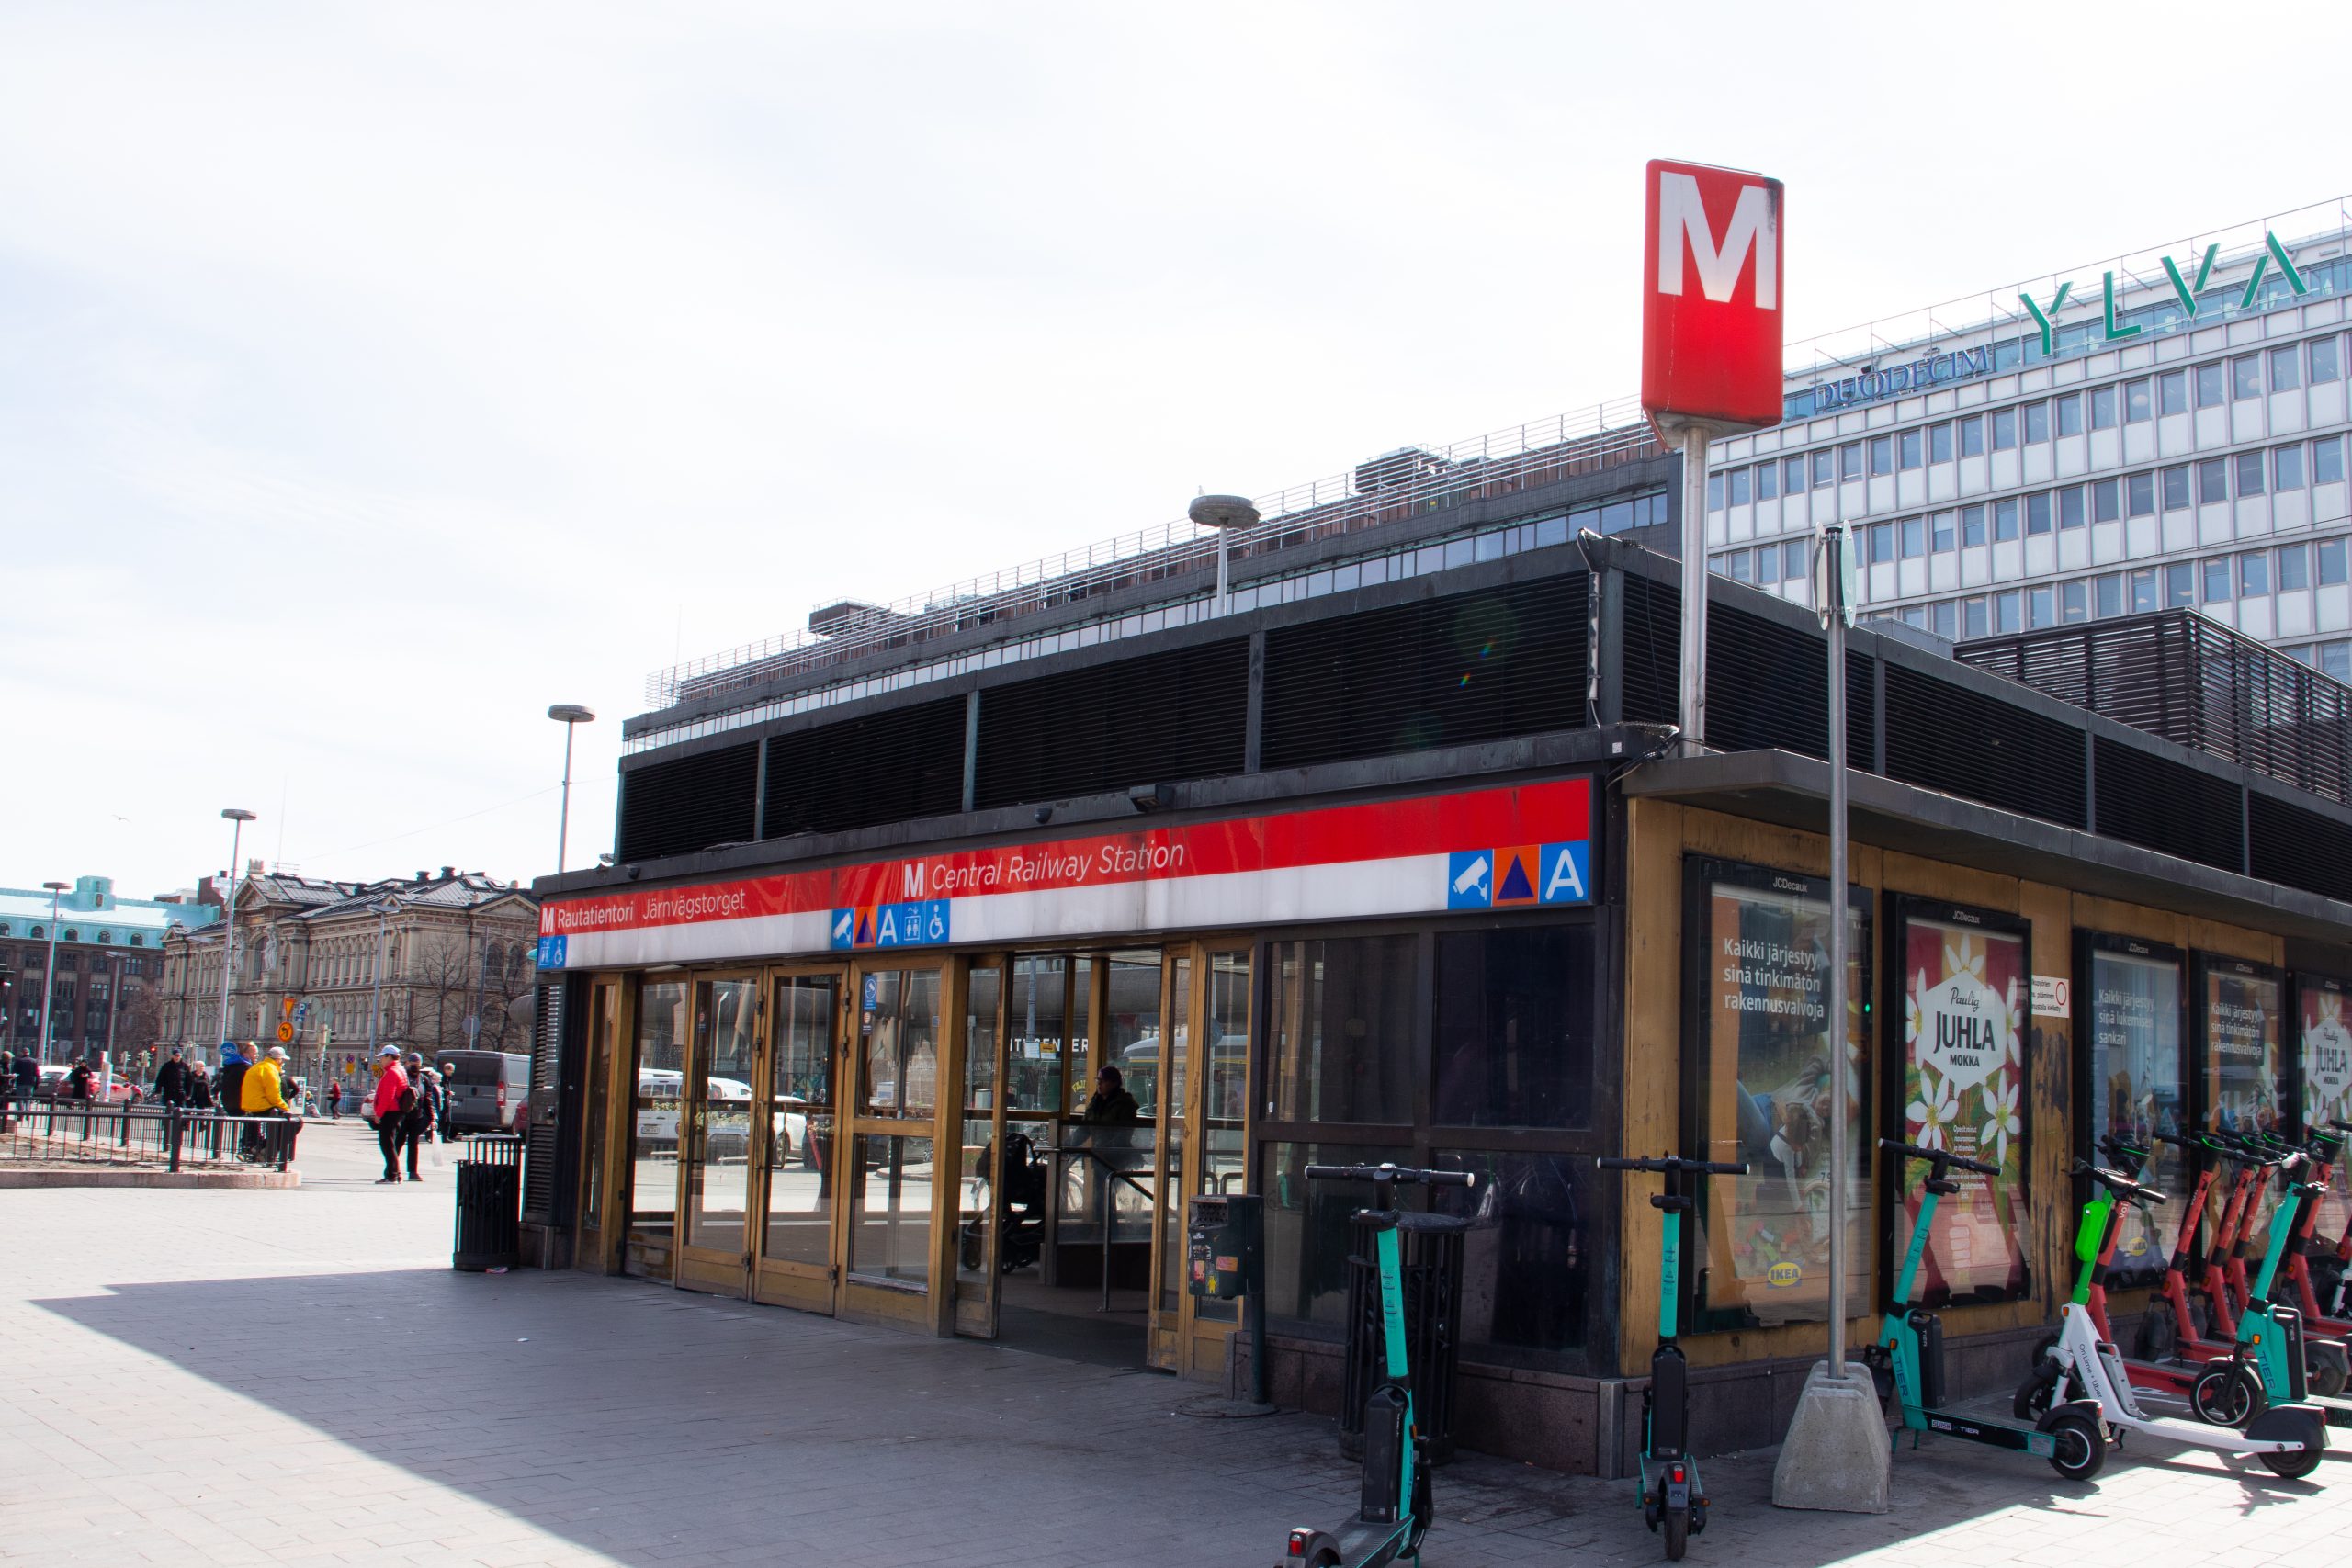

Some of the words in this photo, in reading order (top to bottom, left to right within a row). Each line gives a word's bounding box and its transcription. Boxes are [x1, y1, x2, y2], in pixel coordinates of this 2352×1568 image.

[1657, 170, 1777, 310] M
[2018, 230, 2310, 357] YLVA
[1813, 344, 1991, 412] DUODECIM
[903, 862, 925, 898] M
[932, 861, 1002, 891] Central
[1007, 851, 1093, 883] Railway
[1098, 840, 1185, 874] Station
[1544, 848, 1584, 900] A
[1772, 876, 1809, 893] JCDecaux
[540, 906, 555, 934] M
[558, 901, 634, 930] Rautatientori
[643, 888, 746, 925] Järnvägstorget
[1952, 910, 1980, 924] JCDecaux
[1724, 937, 1765, 960] Kaikki
[1724, 964, 1752, 985] sinä
[1755, 967, 1821, 993] tinkimätön
[1724, 991, 1825, 1022] rakennusvalvoja
[1950, 987, 1980, 1012] Paulig
[2098, 989, 2122, 1006] Kaikki
[2211, 1002, 2231, 1017] Kaikki
[1933, 1010, 1996, 1055] JUHLA
[2098, 1010, 2115, 1025] sinä
[2116, 1011, 2154, 1029] lukemisen
[2211, 1020, 2225, 1034] sinä
[2226, 1023, 2260, 1039] tinkimätön
[2098, 1030, 2127, 1046] sankari
[2211, 1040, 2263, 1059] rakennusvalvoja
[1950, 1054, 1980, 1067] MOKKA
[2314, 1044, 2347, 1077] JUHLA
[1770, 1268, 1800, 1280] IKEA
[1893, 1356, 1909, 1397] TIER
[2079, 1343, 2087, 1355] On
[2083, 1355, 2093, 1375] Lime
[2092, 1379, 2103, 1399] Uber
[2258, 1350, 2276, 1391] TIER
[1959, 1426, 1980, 1436] TIER
